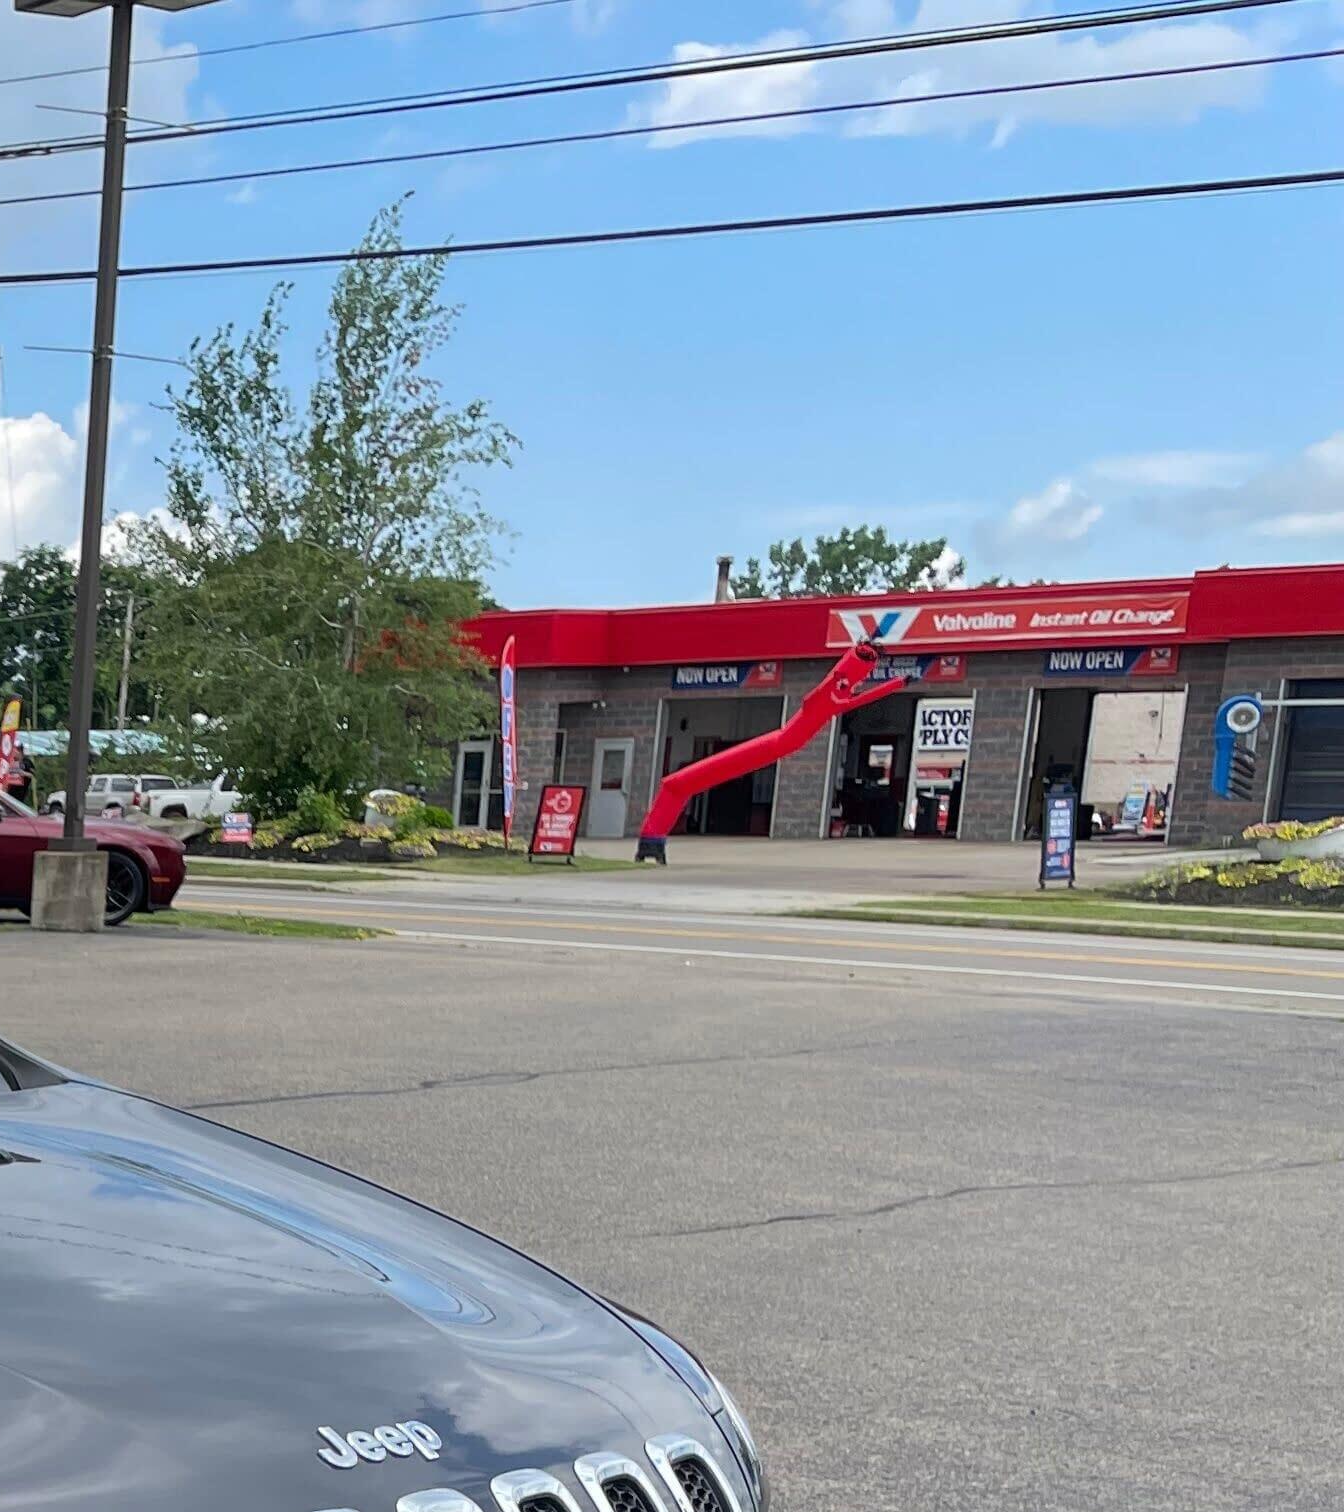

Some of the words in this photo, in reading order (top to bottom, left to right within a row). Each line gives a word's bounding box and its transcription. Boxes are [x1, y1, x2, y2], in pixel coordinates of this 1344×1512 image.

[933, 612, 1016, 631] Valvoline
[1030, 611, 1088, 628] Instant
[1089, 609, 1113, 625] Oil
[1113, 607, 1175, 626] Change
[1050, 651, 1083, 670] NOW
[1085, 650, 1124, 669] OPEN
[676, 666, 705, 684] NOW
[706, 665, 738, 683] OPEN
[317, 1420, 442, 1469] Jeep
